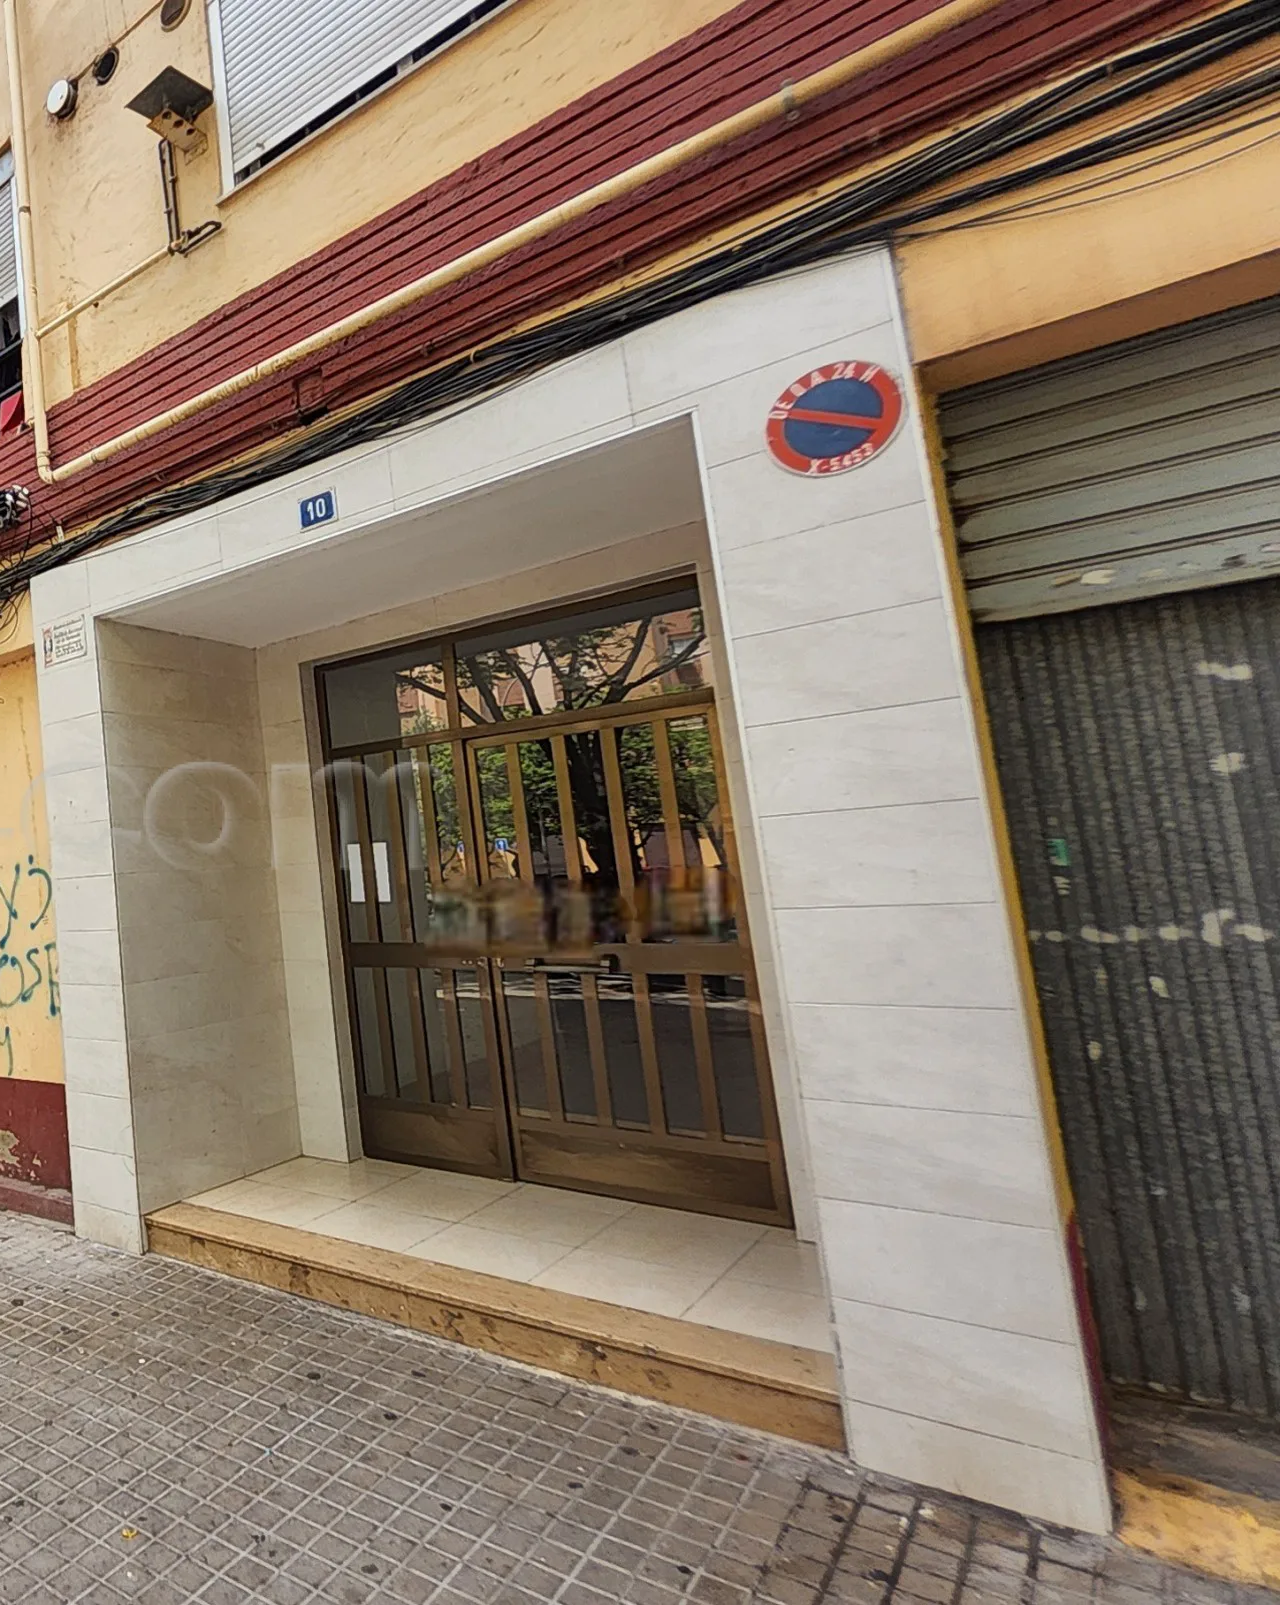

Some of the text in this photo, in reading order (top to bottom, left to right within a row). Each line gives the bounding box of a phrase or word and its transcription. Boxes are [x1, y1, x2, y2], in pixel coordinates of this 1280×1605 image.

[830, 362, 857, 380] 24
[858, 364, 881, 384] H
[307, 498, 326, 521] 10
